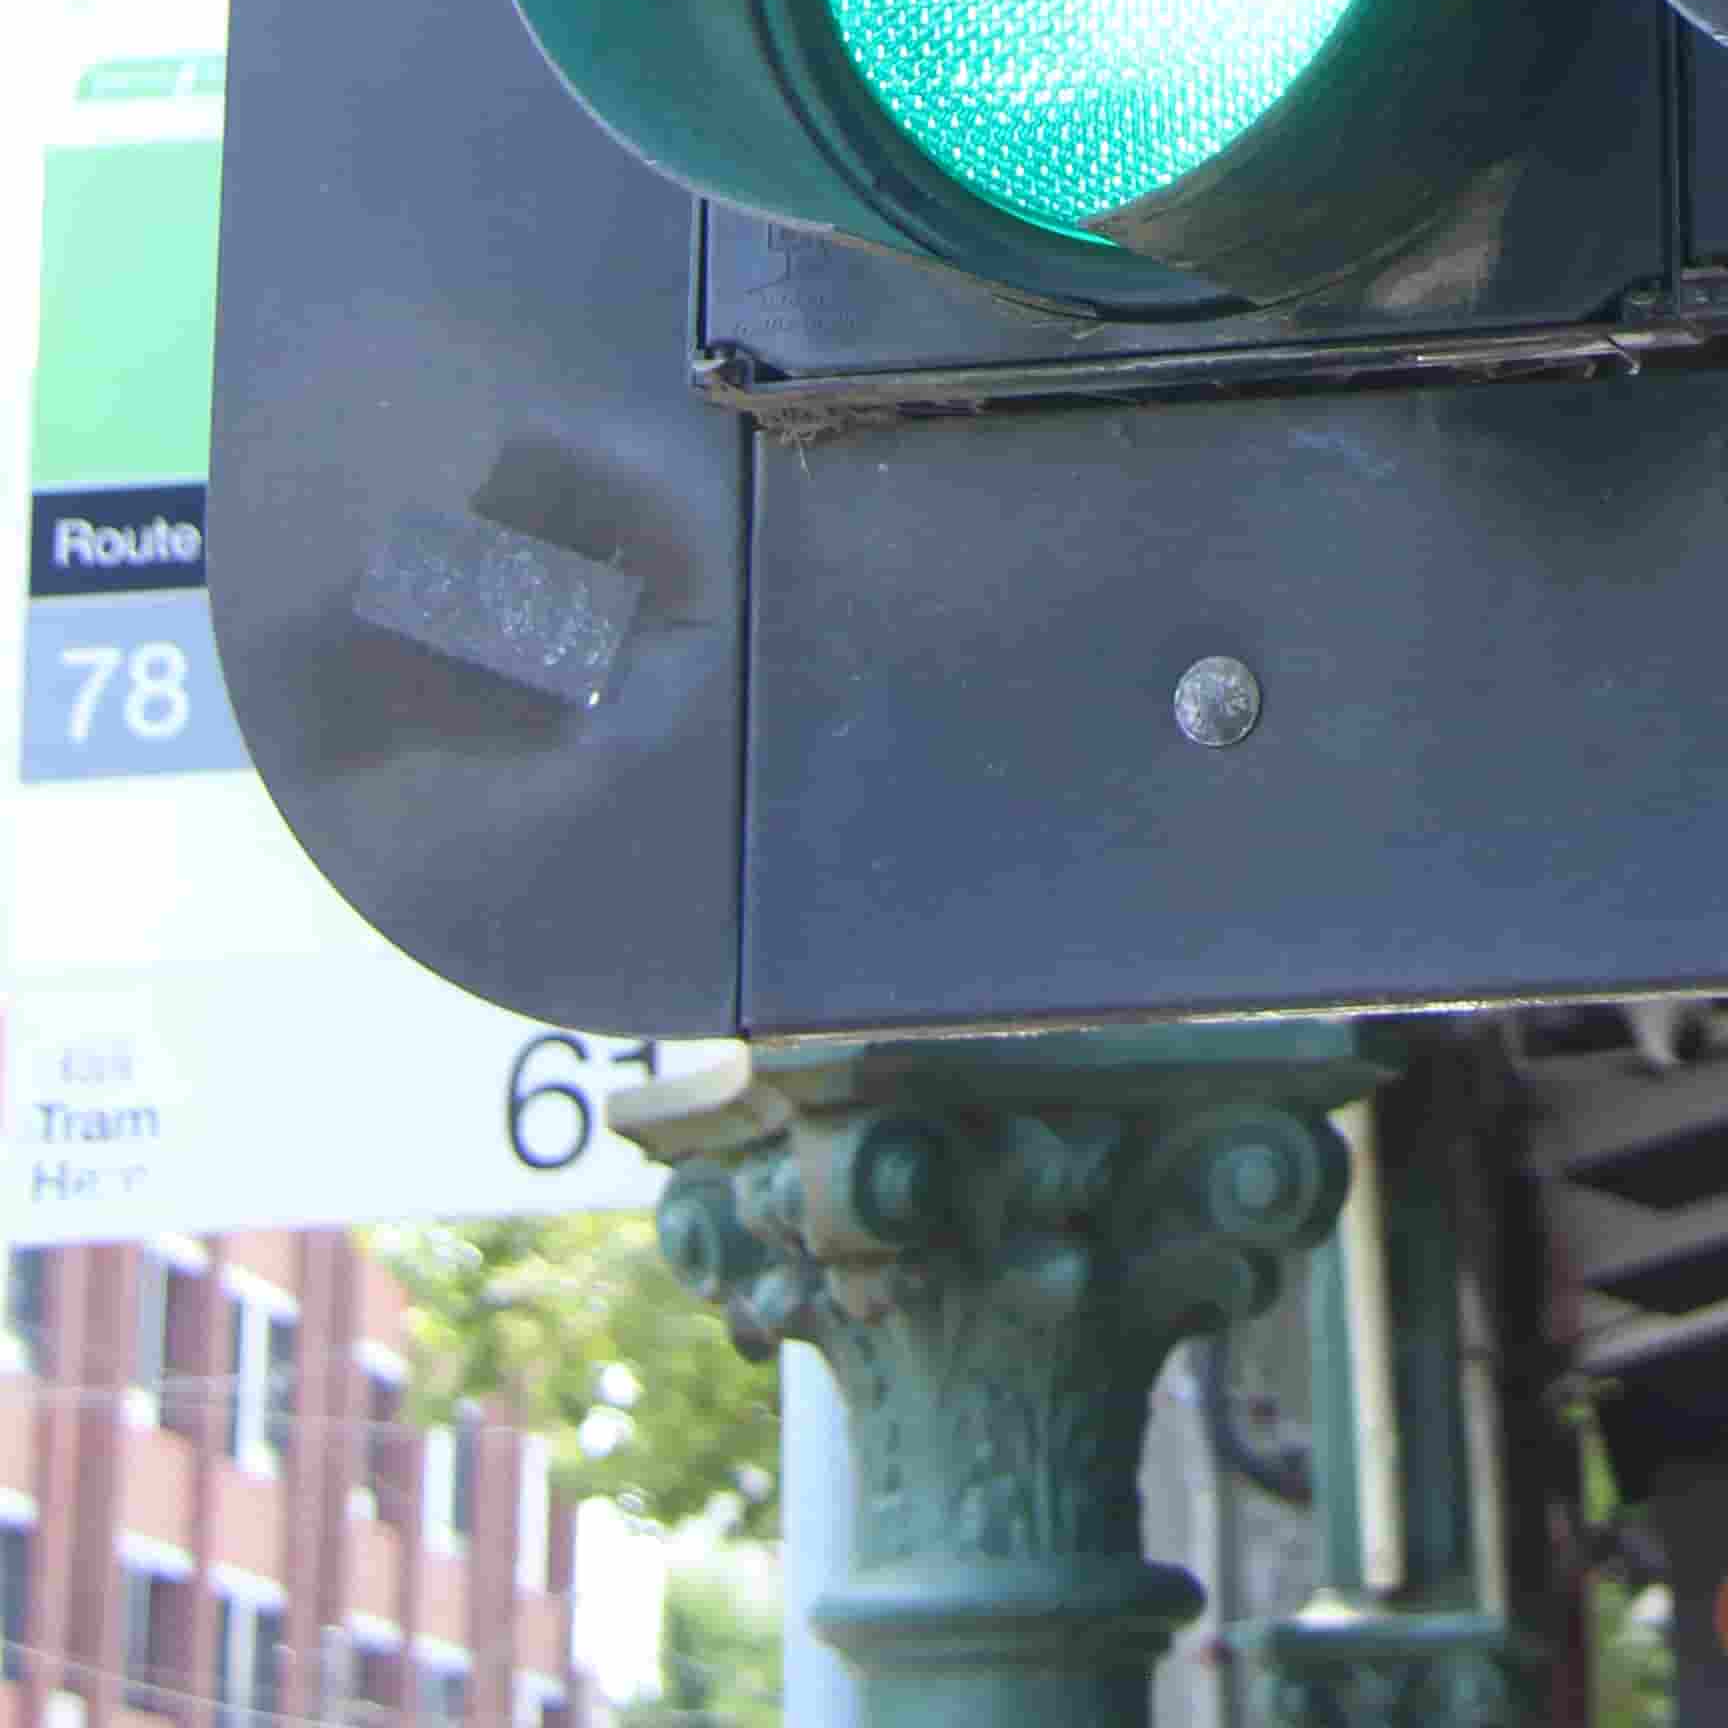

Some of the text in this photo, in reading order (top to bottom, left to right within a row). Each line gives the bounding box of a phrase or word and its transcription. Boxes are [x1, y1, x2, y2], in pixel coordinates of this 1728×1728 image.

[54, 515, 203, 568] Route
[59, 640, 191, 744] 78
[31, 1101, 160, 1144] Tram
